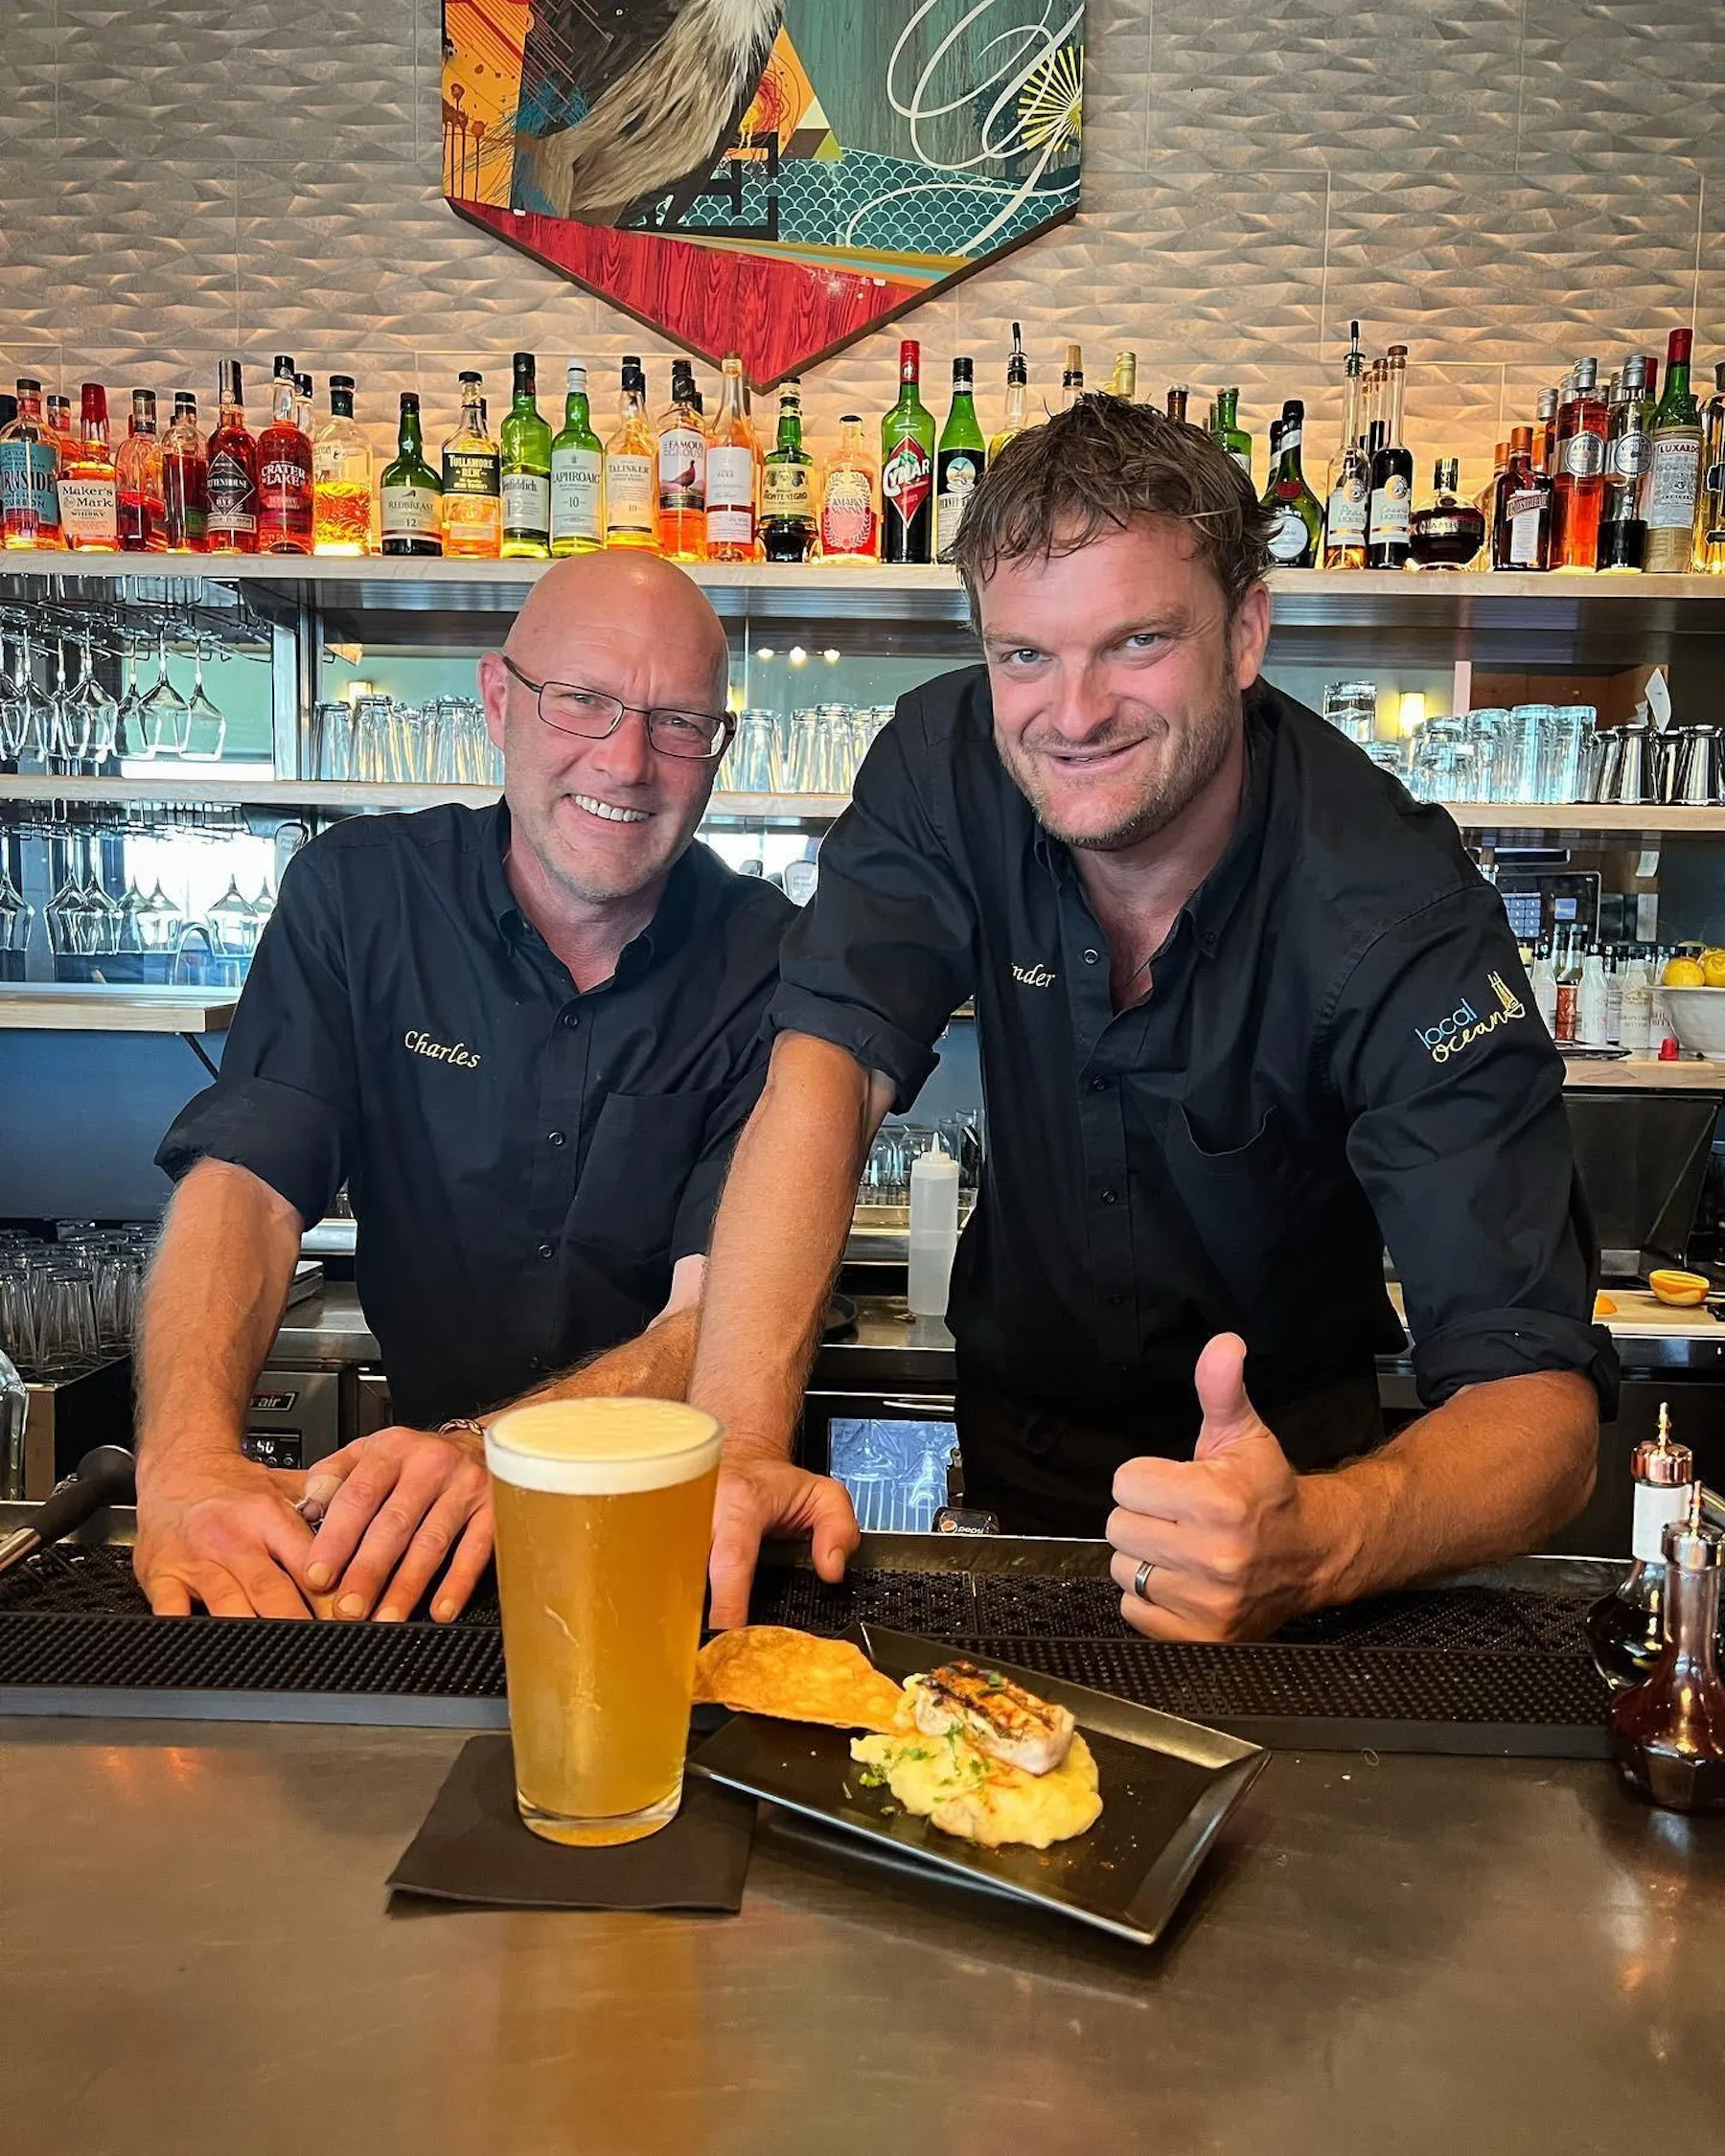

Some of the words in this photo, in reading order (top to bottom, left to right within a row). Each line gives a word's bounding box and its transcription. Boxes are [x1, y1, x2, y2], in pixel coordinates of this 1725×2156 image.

[669, 440, 704, 450] FAMOUS
[1660, 444, 1700, 453] LUXARDO
[448, 454, 494, 470] TULLAMORE
[261, 464, 306, 480] CRATER
[609, 464, 650, 474] TALISKER
[266, 473, 300, 487] LAKE
[62, 486, 113, 496] Maker's
[76, 497, 114, 508] Mark
[388, 500, 434, 514] REDBREAST
[569, 496, 580, 508] 10
[405, 518, 417, 527] 12
[1011, 963, 1056, 988] nder
[1414, 998, 1478, 1050] local
[404, 1030, 482, 1068] Charles
[257, 1396, 282, 1408] air
